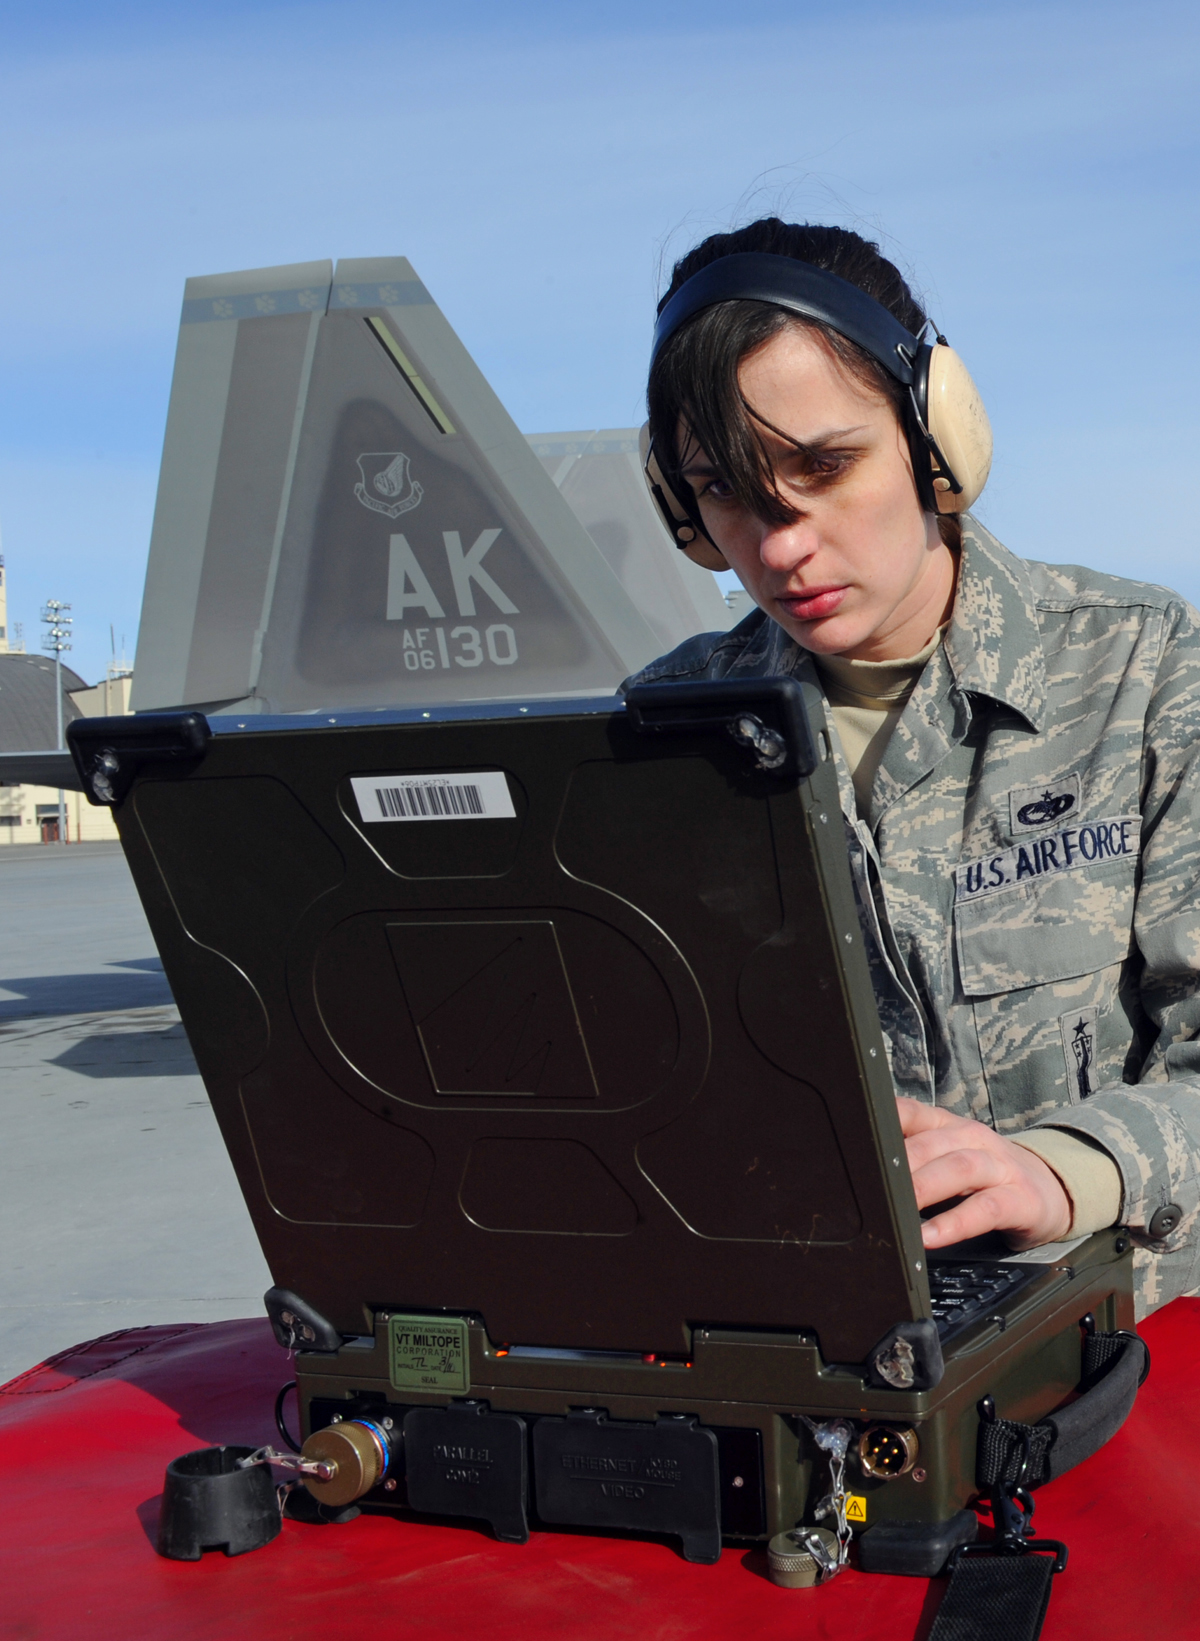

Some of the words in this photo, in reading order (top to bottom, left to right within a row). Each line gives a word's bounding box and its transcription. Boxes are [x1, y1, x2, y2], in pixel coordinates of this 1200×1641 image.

[386, 528, 520, 620] AK
[403, 628, 430, 649] AF
[435, 623, 519, 669] 130
[403, 650, 436, 671] 06
[966, 857, 1011, 893] U.S.
[1016, 838, 1060, 880] AIR
[1062, 821, 1133, 865] FORCE
[424, 1327, 458, 1335] ASSURANCE
[396, 1333, 410, 1345] VT
[413, 1335, 460, 1348] MILTOPE
[396, 1346, 461, 1358] CORPORATION
[421, 1376, 438, 1384] SEAL
[433, 1445, 494, 1463] PARALLEL
[645, 1468, 681, 1480] MOUSE
[601, 1483, 646, 1499] VIDEO
